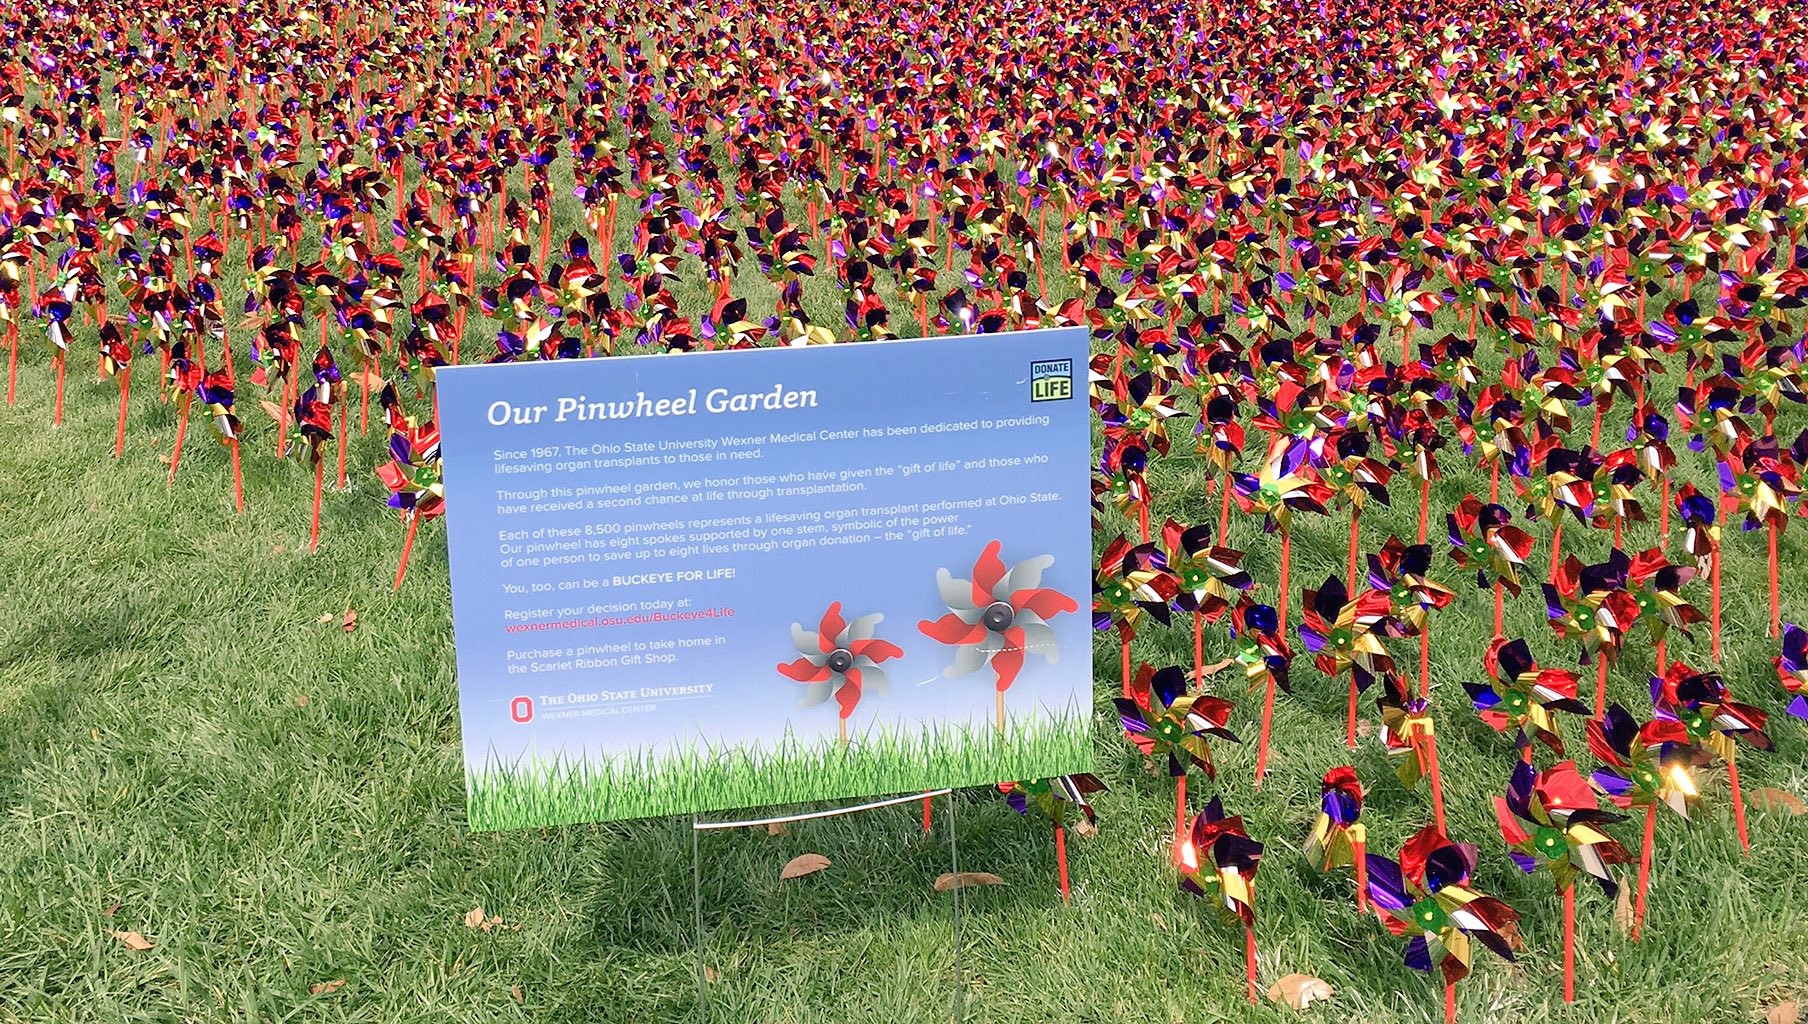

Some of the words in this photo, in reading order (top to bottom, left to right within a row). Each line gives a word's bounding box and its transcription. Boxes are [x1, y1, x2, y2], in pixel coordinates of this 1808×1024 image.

[1034, 362, 1069, 374] DONATE
[1035, 380, 1069, 398] LIFE
[487, 401, 547, 425] Our
[554, 390, 696, 420] Pinwheel
[705, 384, 817, 412] Garden
[493, 449, 527, 460] Since
[530, 446, 561, 457] 1967,
[564, 445, 588, 455] The
[591, 443, 621, 454] Ohio
[624, 442, 655, 452] State
[658, 438, 718, 450] University
[720, 436, 766, 445] Wexner
[770, 431, 816, 442] Medical
[819, 429, 859, 440] Center
[862, 427, 883, 436] has
[886, 426, 916, 435] been
[919, 420, 978, 432] dedicated
[981, 419, 993, 428] to
[996, 415, 1049, 428] providing
[494, 462, 552, 473] lifesaving
[555, 460, 591, 471] organ
[594, 456, 660, 467] transplants
[663, 455, 676, 463] to
[678, 453, 712, 462] those
[716, 451, 726, 460] in
[730, 448, 763, 459] need.
[496, 488, 547, 500] Through
[550, 487, 572, 497] this
[576, 483, 630, 496] pinwheel
[634, 481, 680, 494] garden,
[683, 480, 701, 488] we
[704, 477, 739, 486] honor
[742, 475, 776, 484] those
[779, 472, 804, 481] who
[807, 470, 836, 480] have
[839, 468, 871, 480] given
[875, 466, 894, 476] the
[923, 461, 936, 472] of
[964, 458, 985, 469] and
[988, 457, 1021, 466] those
[1023, 454, 1048, 463] who
[497, 504, 527, 513] have
[530, 500, 582, 511] received
[586, 500, 593, 508] a
[597, 496, 641, 507] second
[644, 494, 688, 504] chance
[691, 492, 703, 501] at
[706, 490, 724, 500] life
[727, 488, 773, 499] through
[776, 482, 866, 495] transplantation.
[499, 529, 528, 540] Each
[532, 527, 544, 538] of
[547, 527, 581, 537] these
[584, 523, 620, 534] 8,500
[624, 520, 684, 533] pinwheels
[688, 516, 751, 528] represents
[754, 515, 762, 523] a
[765, 512, 820, 522] lifesaving
[823, 509, 858, 520] organ
[861, 503, 919, 515] transplant
[922, 498, 982, 512] performed
[985, 497, 996, 506] at
[999, 494, 1026, 504] Ohio
[1029, 492, 1061, 502] State.
[499, 543, 522, 554] Our
[526, 540, 581, 553] pinwheel
[584, 539, 606, 548] has
[609, 536, 639, 548] eight
[642, 534, 685, 545] spokes
[689, 528, 749, 541] supported
[753, 527, 767, 538] by
[770, 527, 793, 535] one
[796, 524, 828, 533] stem,
[831, 519, 882, 532] symbolic
[885, 517, 897, 527] of
[900, 516, 919, 526] the
[922, 514, 958, 526] power
[500, 556, 513, 567] of
[516, 557, 539, 566] one
[543, 554, 585, 566] person
[588, 553, 600, 561] to
[603, 551, 631, 560] save
[635, 550, 650, 559] up
[653, 548, 665, 557] to
[669, 545, 699, 557] eight
[702, 544, 729, 553] lives
[732, 540, 778, 551] through
[781, 538, 815, 549] organ
[819, 534, 870, 545] donation
[884, 531, 903, 540] the
[933, 526, 945, 536] of
[502, 583, 528, 593] You,
[531, 583, 554, 591] too,
[558, 581, 579, 589] can
[583, 578, 598, 588] be
[602, 578, 609, 586] a
[612, 572, 673, 585] BUCKEYE
[676, 570, 703, 580] FOR
[706, 568, 735, 579] LIFE!
[504, 608, 554, 620] Register
[556, 607, 584, 618] your
[587, 602, 637, 613] decision
[640, 599, 674, 609] today
[677, 598, 691, 607] at:
[505, 607, 736, 633] wexnermedical.osu.edu/Buckeye4Life
[506, 649, 562, 659] Purchase
[566, 647, 573, 655] a
[576, 642, 630, 656] pinwheel
[634, 642, 646, 650] to
[649, 640, 675, 649] take
[678, 637, 712, 646] home
[715, 635, 725, 644] in
[507, 664, 527, 673] the
[530, 661, 572, 672] Scarlet
[575, 658, 617, 668] Ribbon
[620, 654, 641, 665] Gift
[644, 653, 678, 663] Shop.
[539, 695, 564, 705] THE
[567, 693, 598, 702] OHIO
[601, 690, 637, 700] STATE
[640, 684, 713, 696] UNIVERSITY
[541, 710, 579, 719] WEXNER
[581, 707, 620, 716] MEDICAL
[621, 704, 656, 713] CENTER
